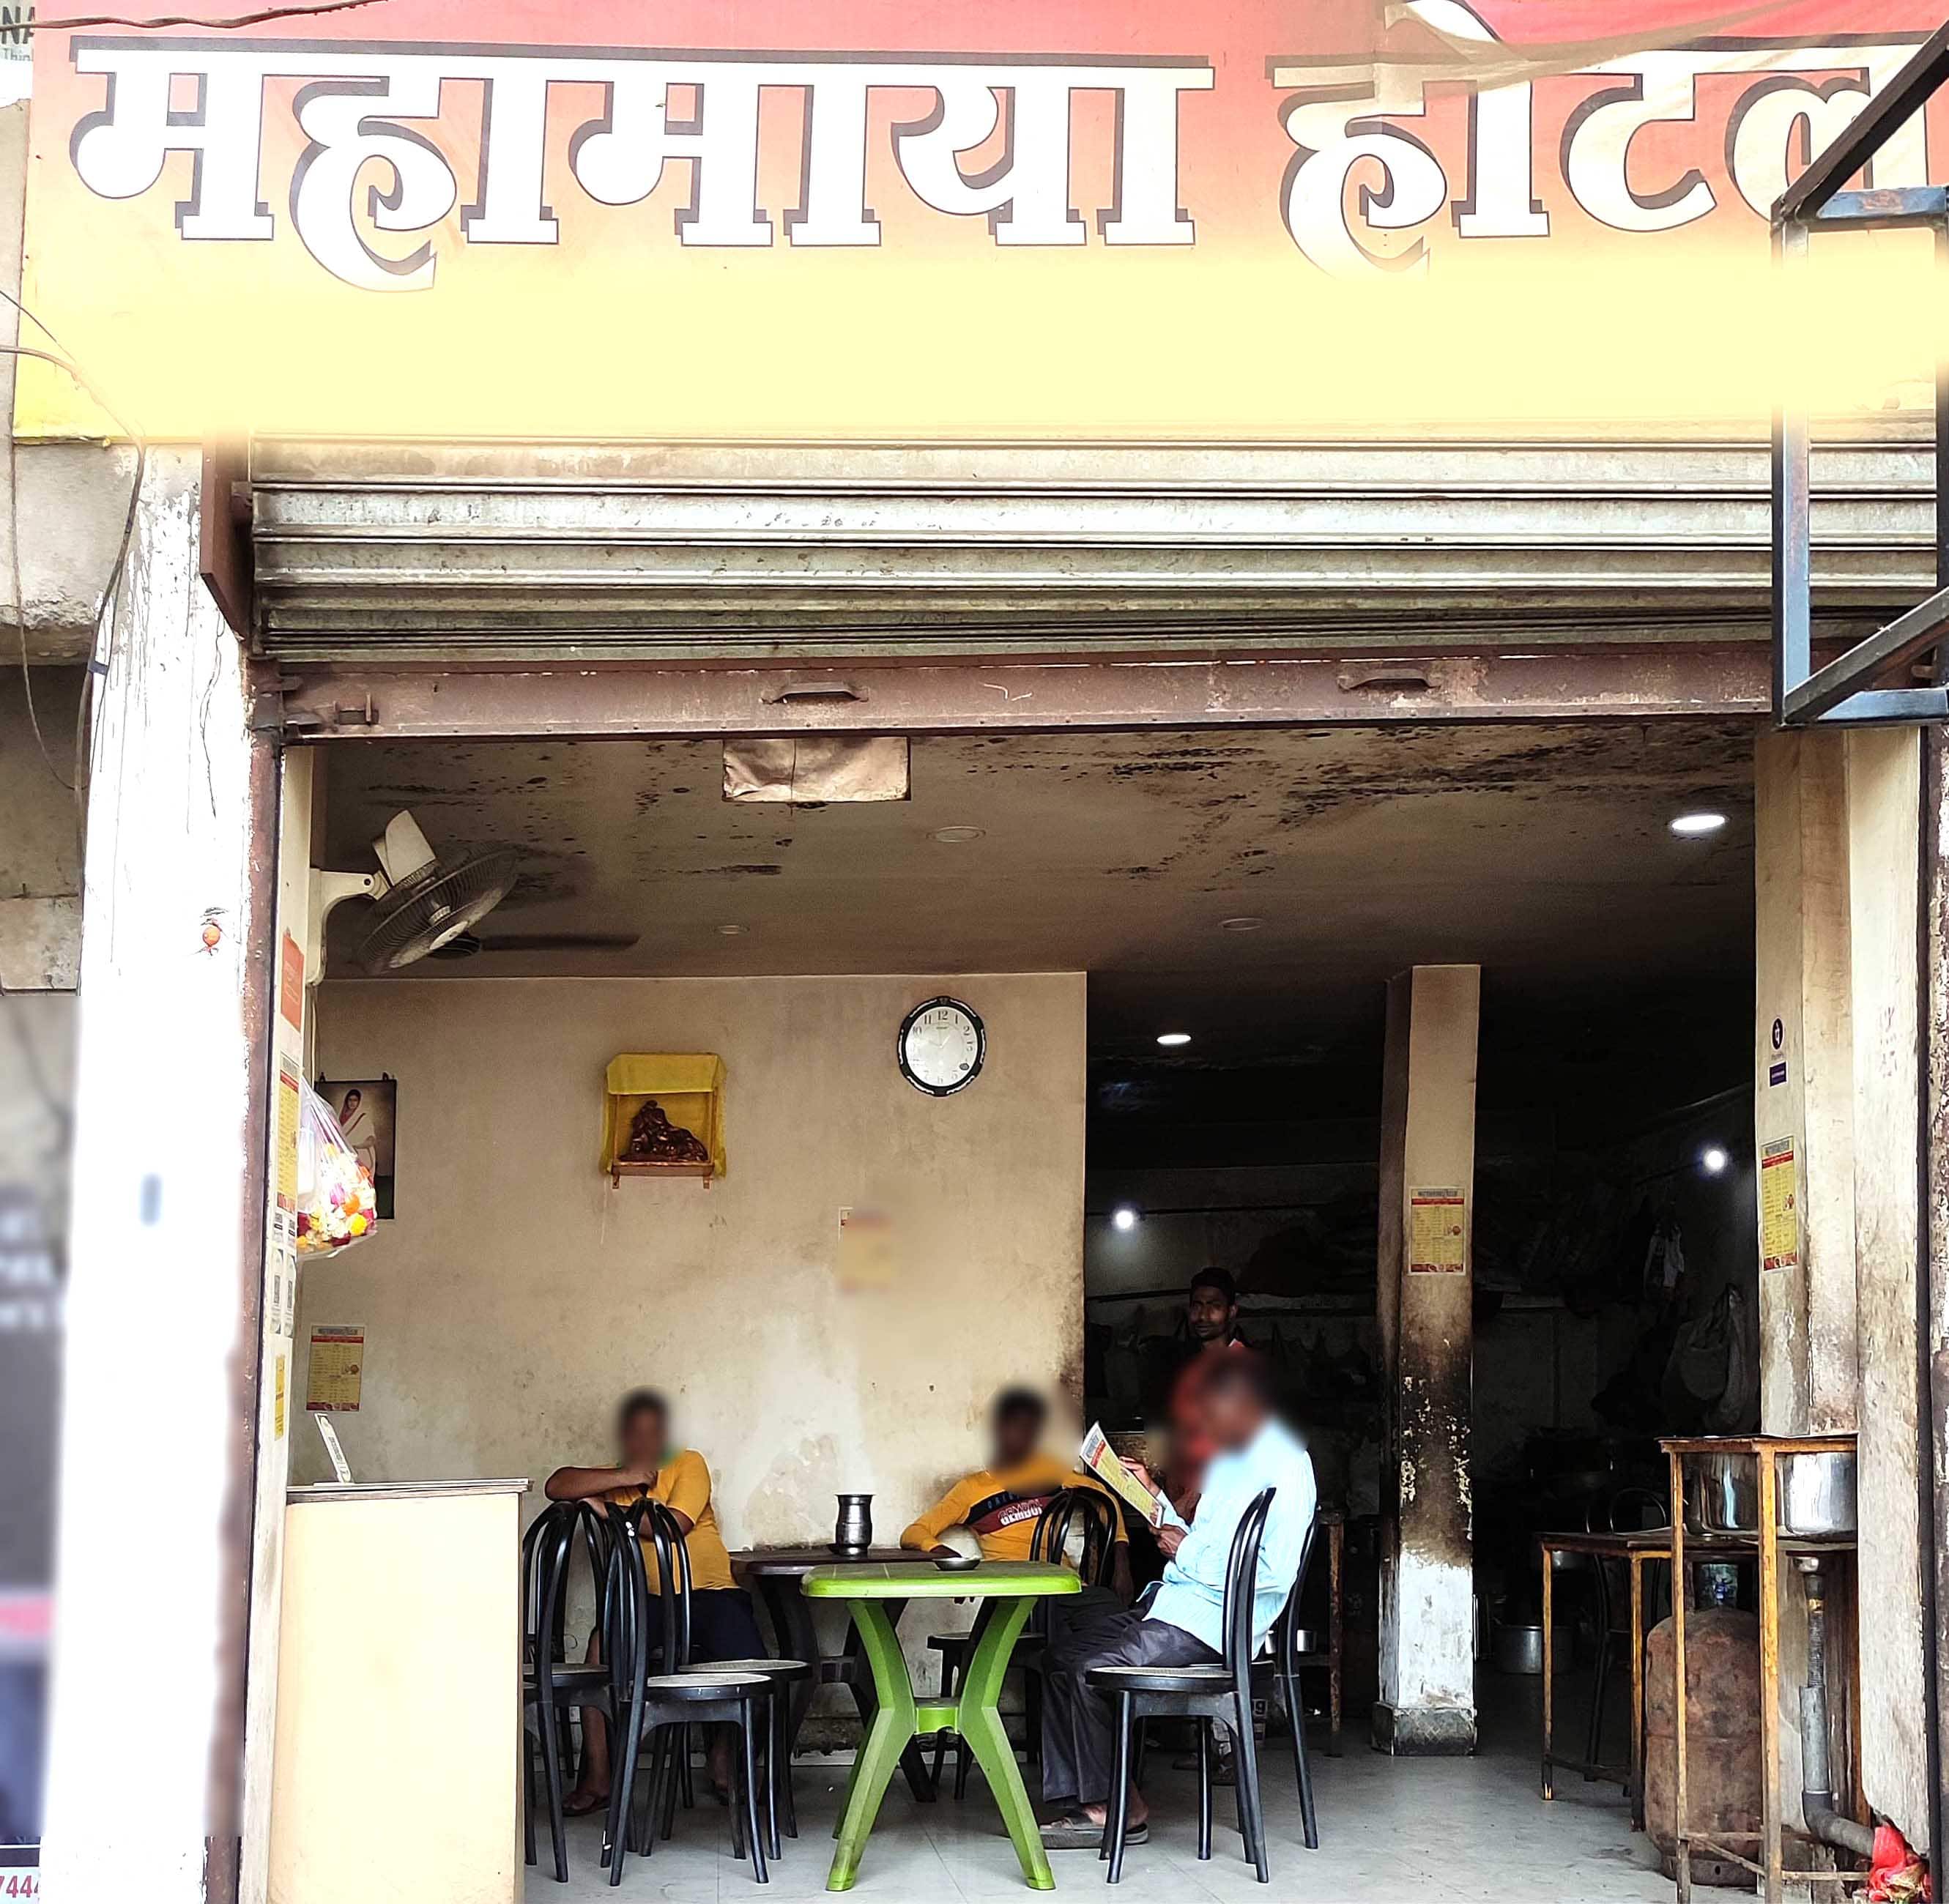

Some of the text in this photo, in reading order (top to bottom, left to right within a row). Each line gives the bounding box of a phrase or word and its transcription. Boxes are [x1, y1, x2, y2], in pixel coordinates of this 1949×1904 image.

[70, 0, 1941, 292] महामाया होटल
[938, 1010, 948, 1020] 12
[963, 1025, 970, 1036] 2
